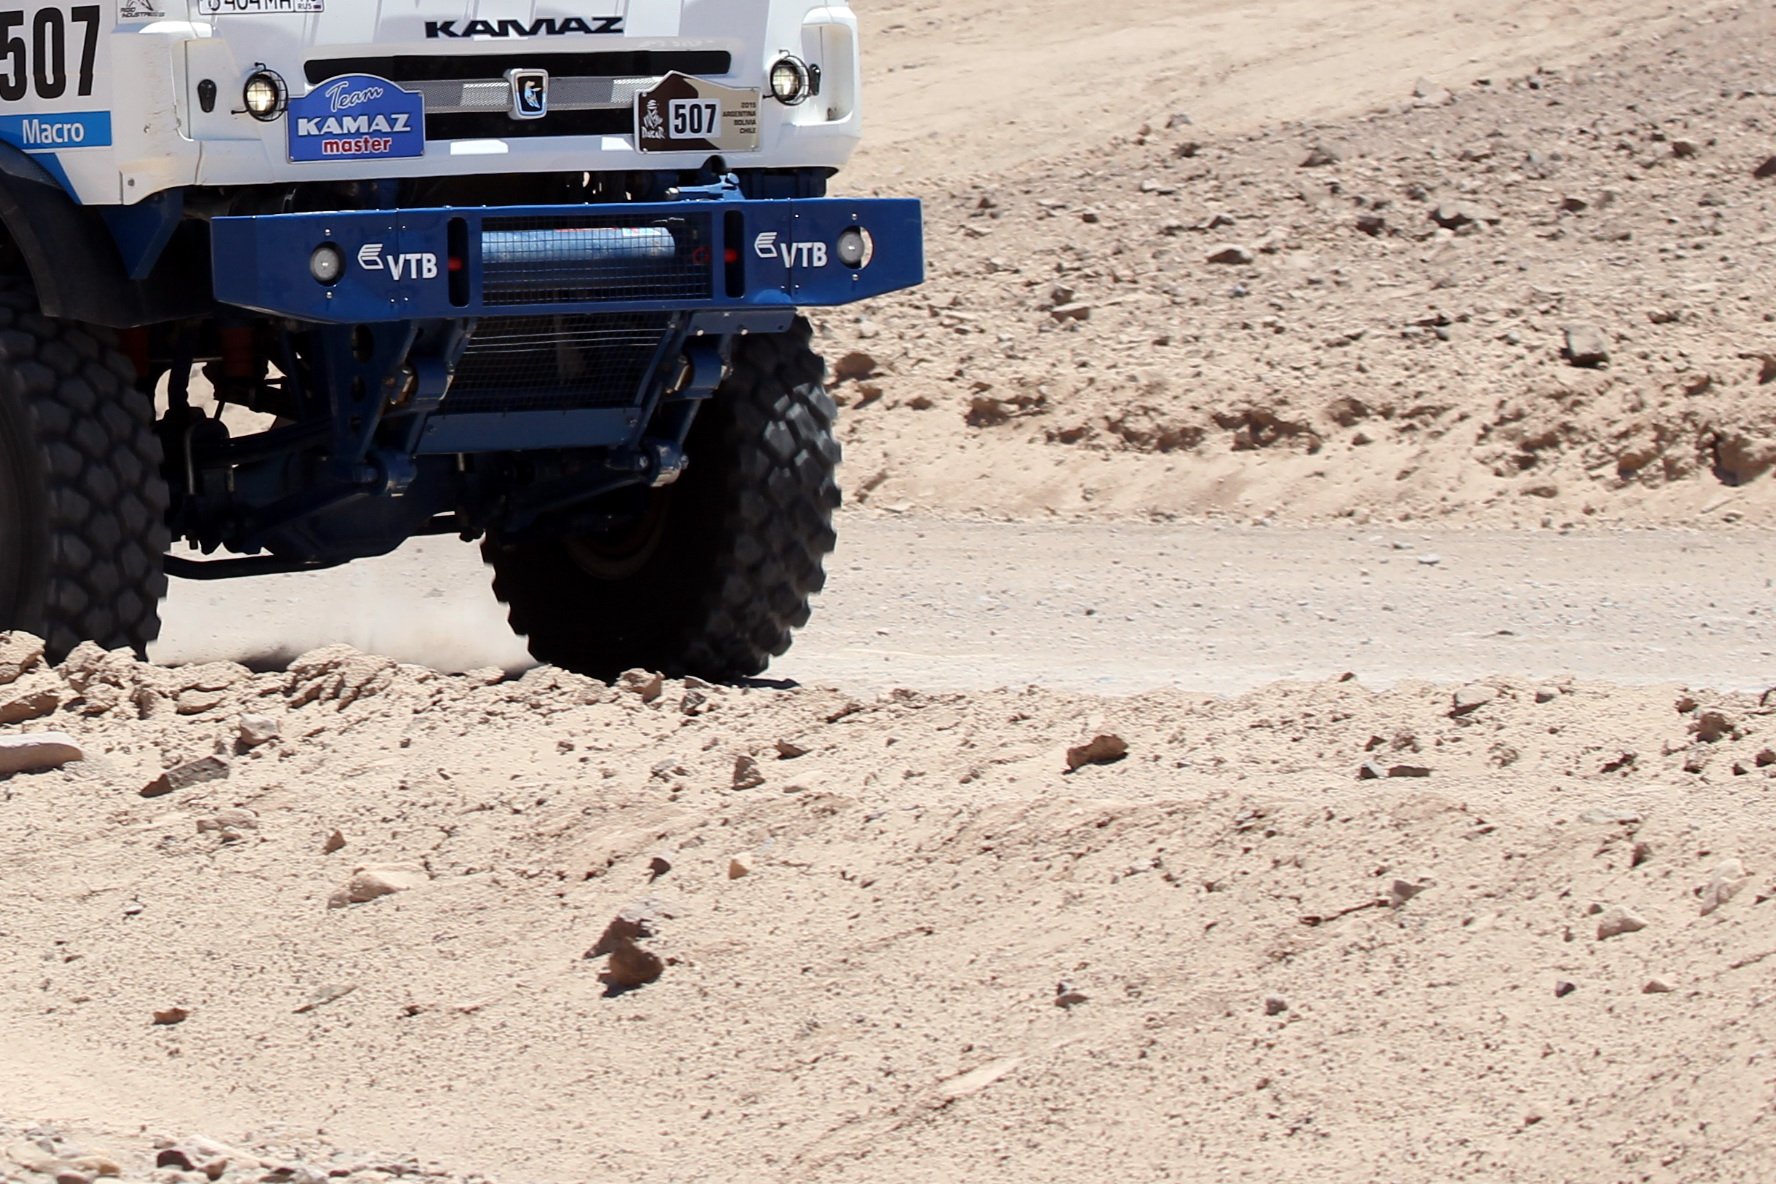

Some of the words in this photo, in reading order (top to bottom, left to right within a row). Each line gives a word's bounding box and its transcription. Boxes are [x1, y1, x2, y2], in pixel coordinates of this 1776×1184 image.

[297, 2, 313, 10] RUS
[425, 16, 624, 39] KAMAZ
[326, 81, 384, 112] Team
[22, 118, 85, 144] Macro
[297, 113, 411, 136] KAMAZ
[674, 103, 717, 134] 507
[322, 136, 393, 155] master
[386, 252, 438, 281] VTB
[780, 241, 828, 268] VTB
